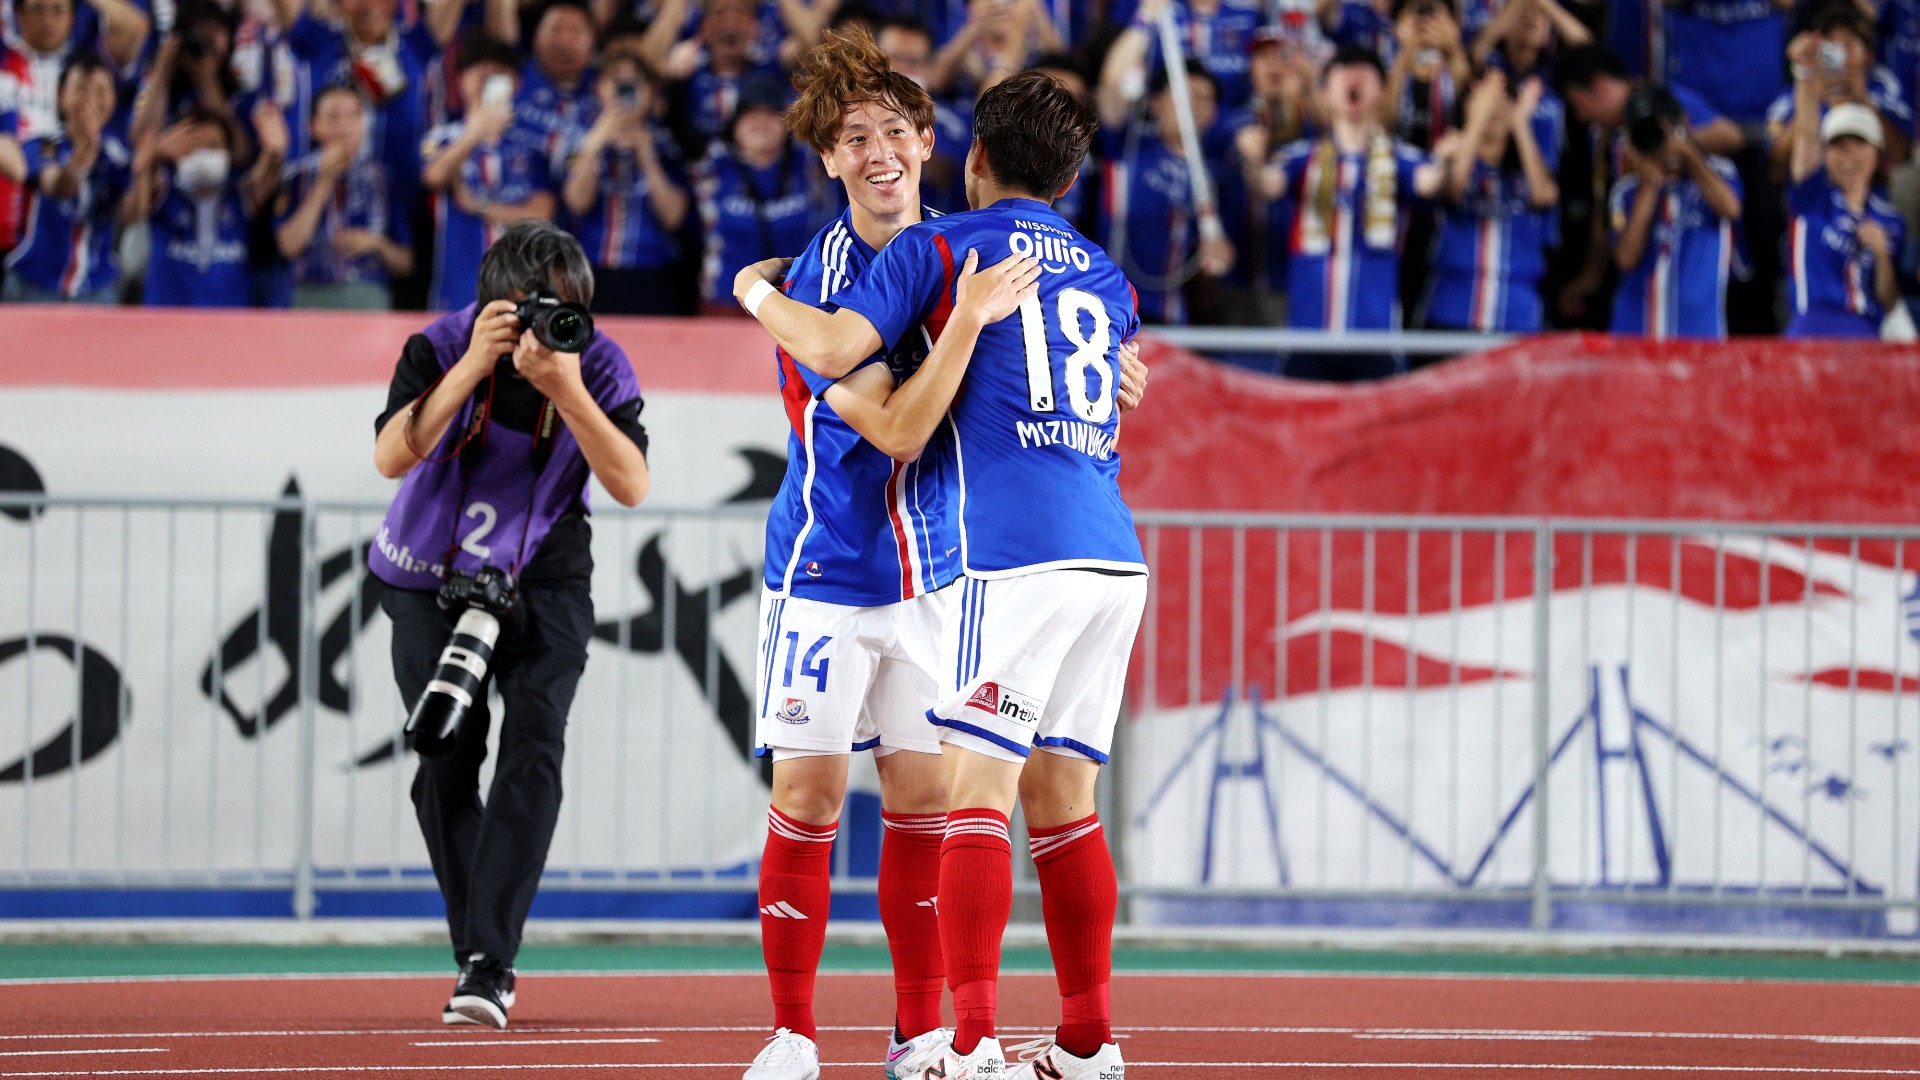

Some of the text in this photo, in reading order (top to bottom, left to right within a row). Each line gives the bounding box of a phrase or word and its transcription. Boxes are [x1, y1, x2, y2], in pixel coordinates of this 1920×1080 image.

[1014, 219, 1075, 241] NISSHIN
[1019, 286, 1115, 425] 18
[460, 501, 498, 559] 2
[782, 630, 834, 693] 14
